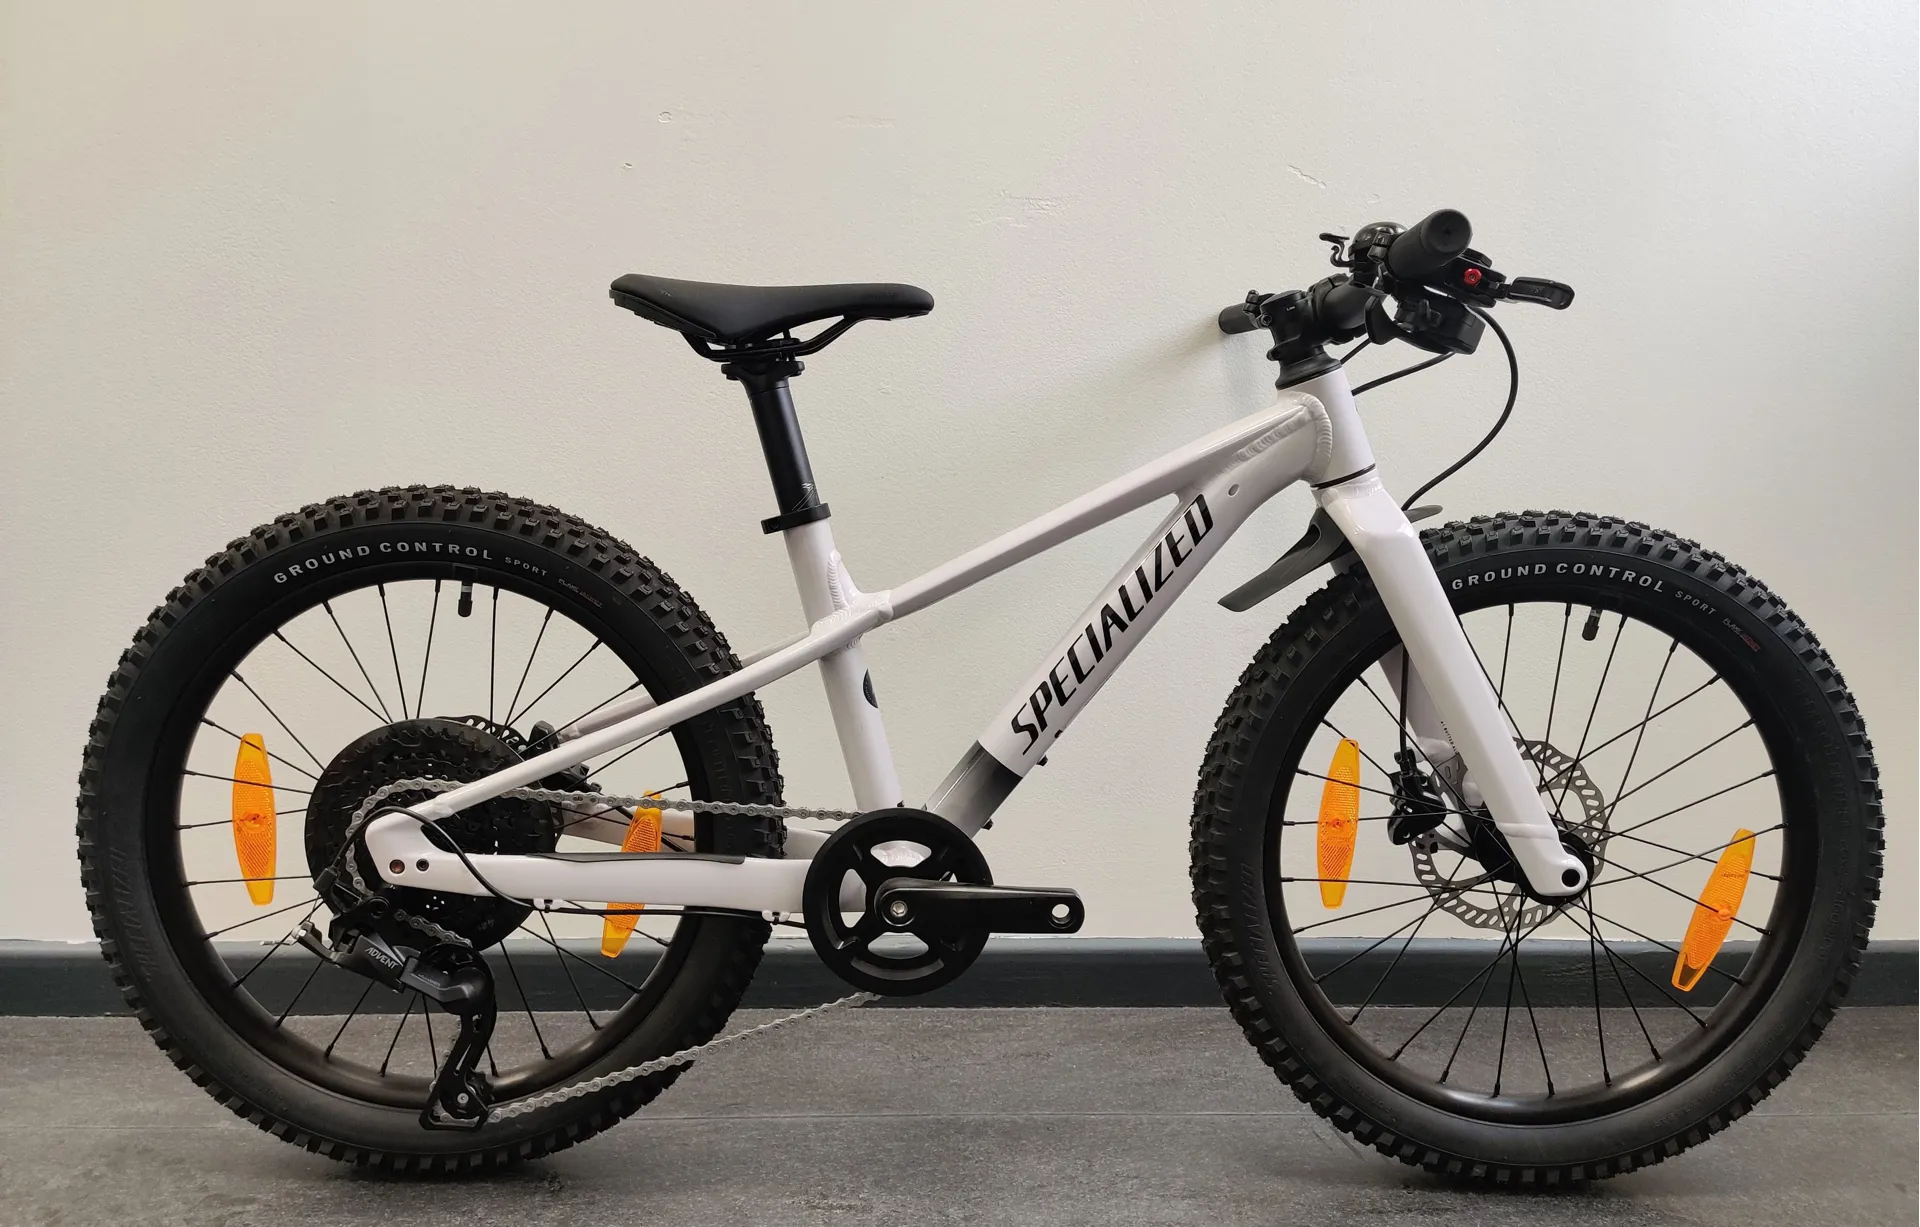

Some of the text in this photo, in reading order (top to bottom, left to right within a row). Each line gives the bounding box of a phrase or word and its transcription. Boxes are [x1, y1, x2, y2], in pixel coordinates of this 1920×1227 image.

[274, 542, 548, 584] GROUND CONTROL SPORT
[1452, 563, 1547, 590] GROUND
[1556, 563, 1663, 593] CONTROL
[1675, 590, 1716, 615] SPORT
[1011, 493, 1214, 756] SPECIALIZED
[364, 946, 399, 970] ADVENT
